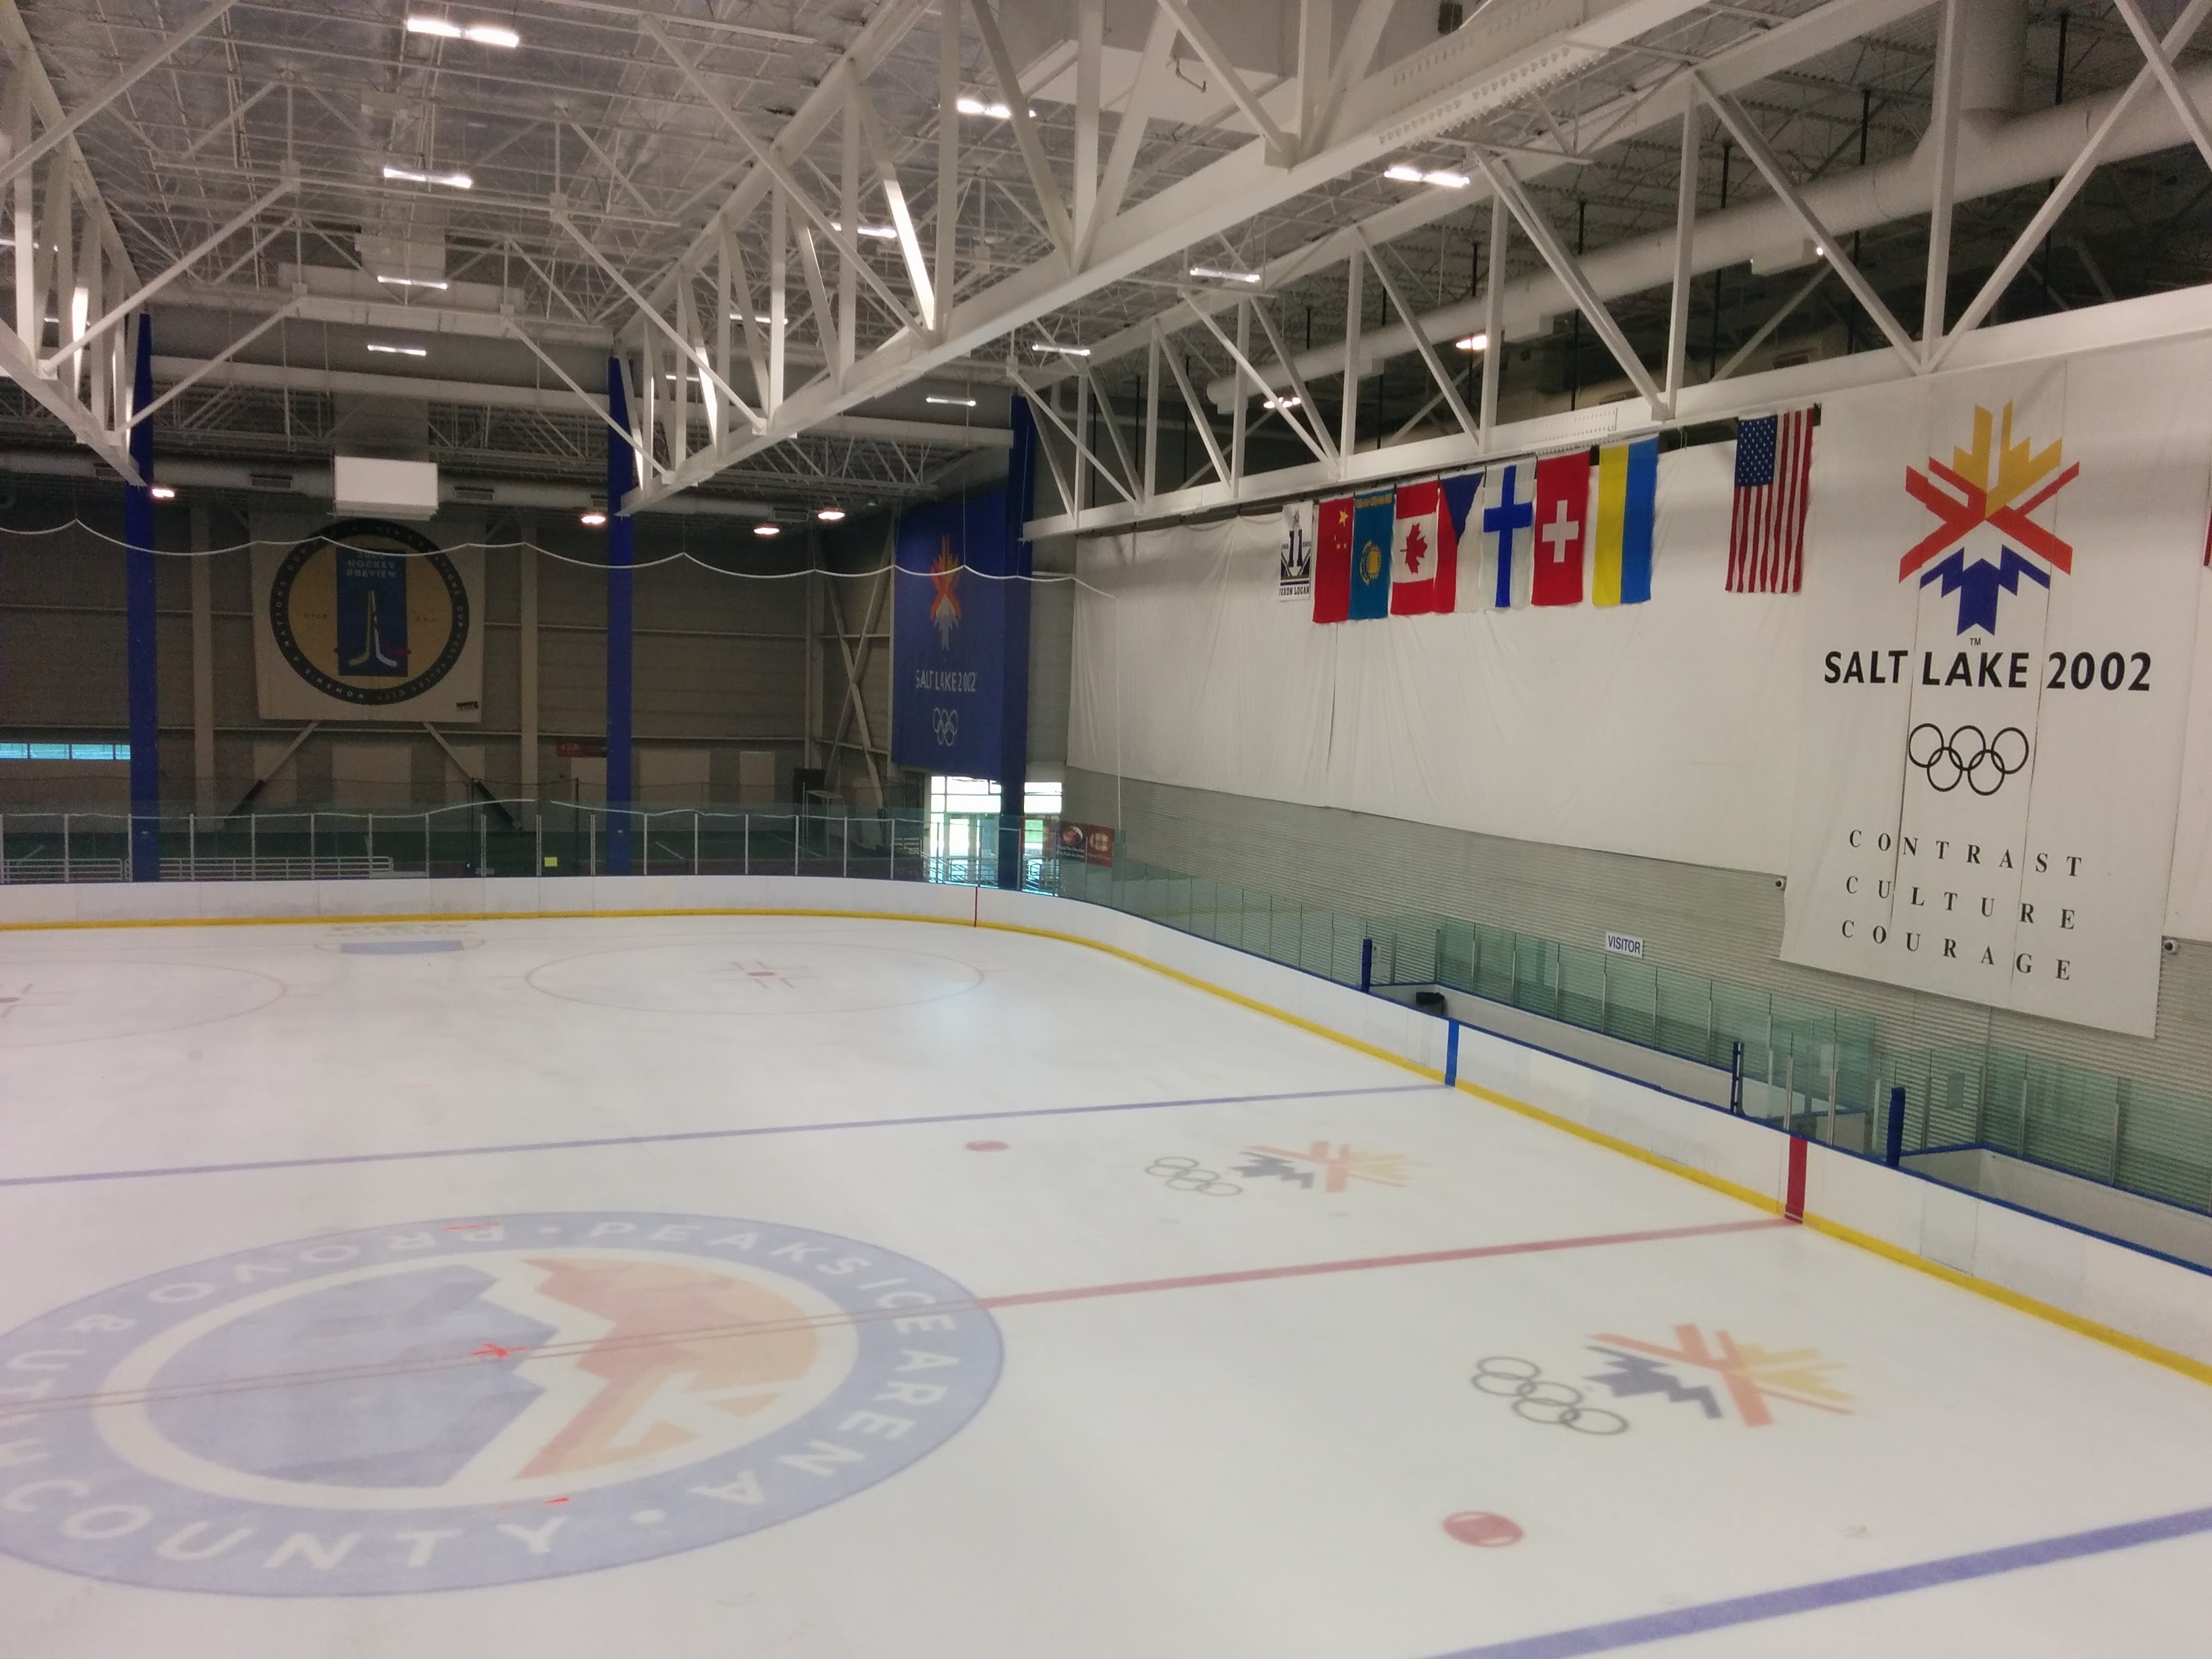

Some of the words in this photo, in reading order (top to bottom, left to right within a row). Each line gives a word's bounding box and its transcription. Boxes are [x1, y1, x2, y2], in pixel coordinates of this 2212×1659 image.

[346, 569, 396, 577] PREVIEW
[348, 560, 395, 569] HOCKEY
[916, 670, 933, 689] SALT
[935, 671, 957, 692] LAKE
[958, 672, 976, 692] 2002
[1824, 651, 1908, 683] SALT
[1922, 651, 2029, 687] LAKE
[2047, 651, 2151, 691] 2002
[1849, 829, 2082, 877] CONTRAST
[1846, 876, 2075, 930] CULTURE
[1608, 935, 1641, 954] VISITOR
[1841, 920, 2070, 981] COURAGE
[587, 1221, 872, 1275] PEAKS
[684, 1348, 960, 1506] ARENA
[2, 1479, 568, 1570] COUNTY
